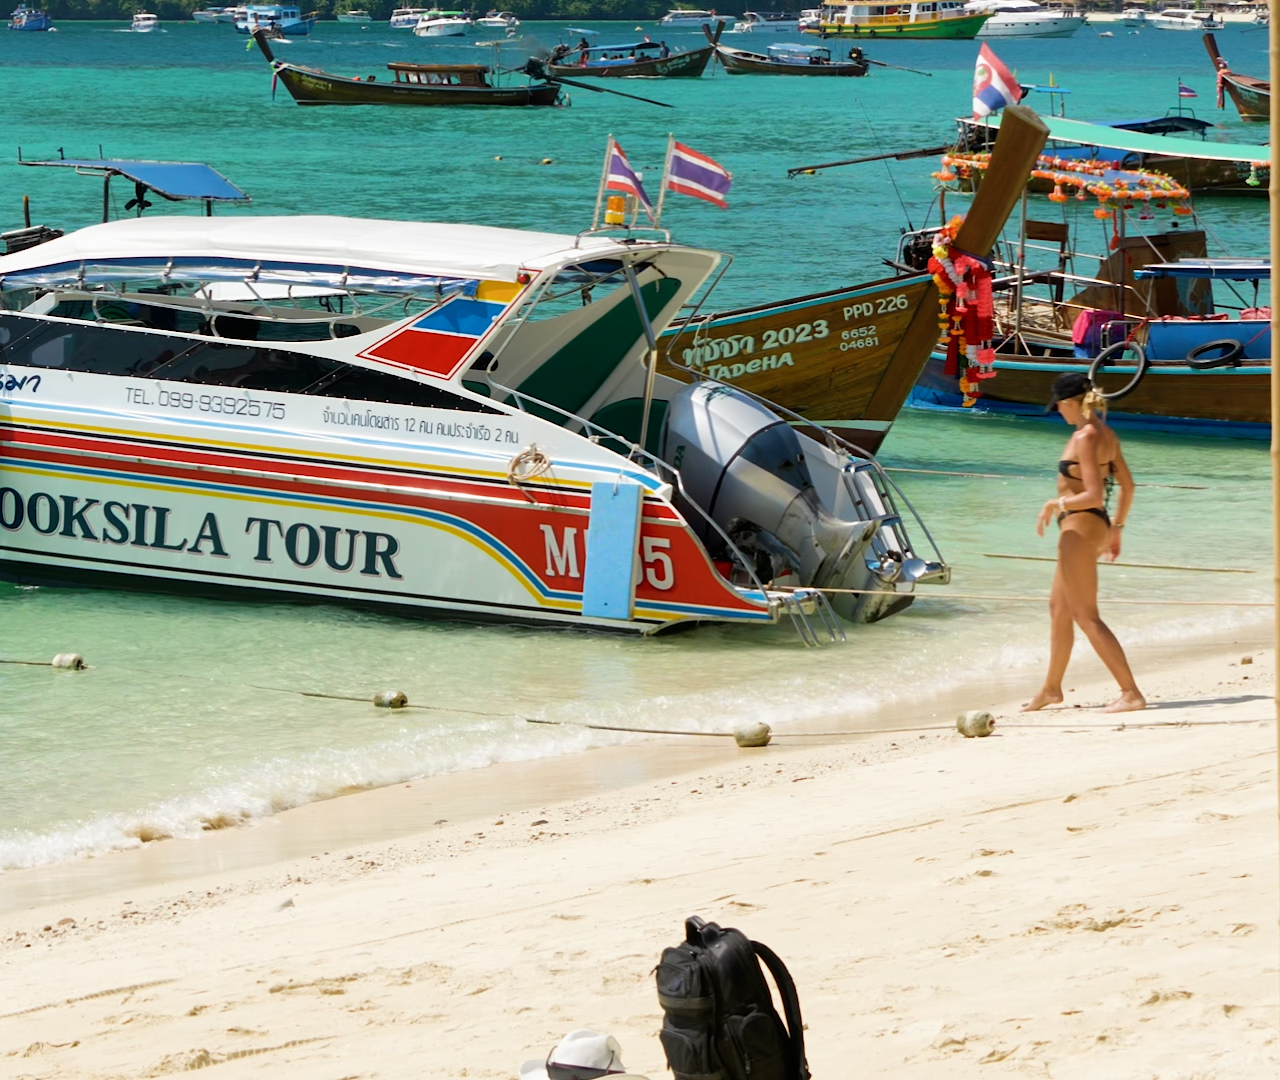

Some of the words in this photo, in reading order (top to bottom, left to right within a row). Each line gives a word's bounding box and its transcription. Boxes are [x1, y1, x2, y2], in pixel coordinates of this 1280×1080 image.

[843, 302, 874, 321] PPD
[875, 294, 909, 315] 226
[761, 320, 831, 351] 2023
[840, 337, 879, 352] 04681
[841, 325, 877, 340] 6652
[125, 387, 154, 406] TEL.
[158, 390, 286, 420] 099-9392575
[404, 417, 416, 433] 12
[495, 428, 502, 442] 2
[245, 517, 405, 580] TOUR
